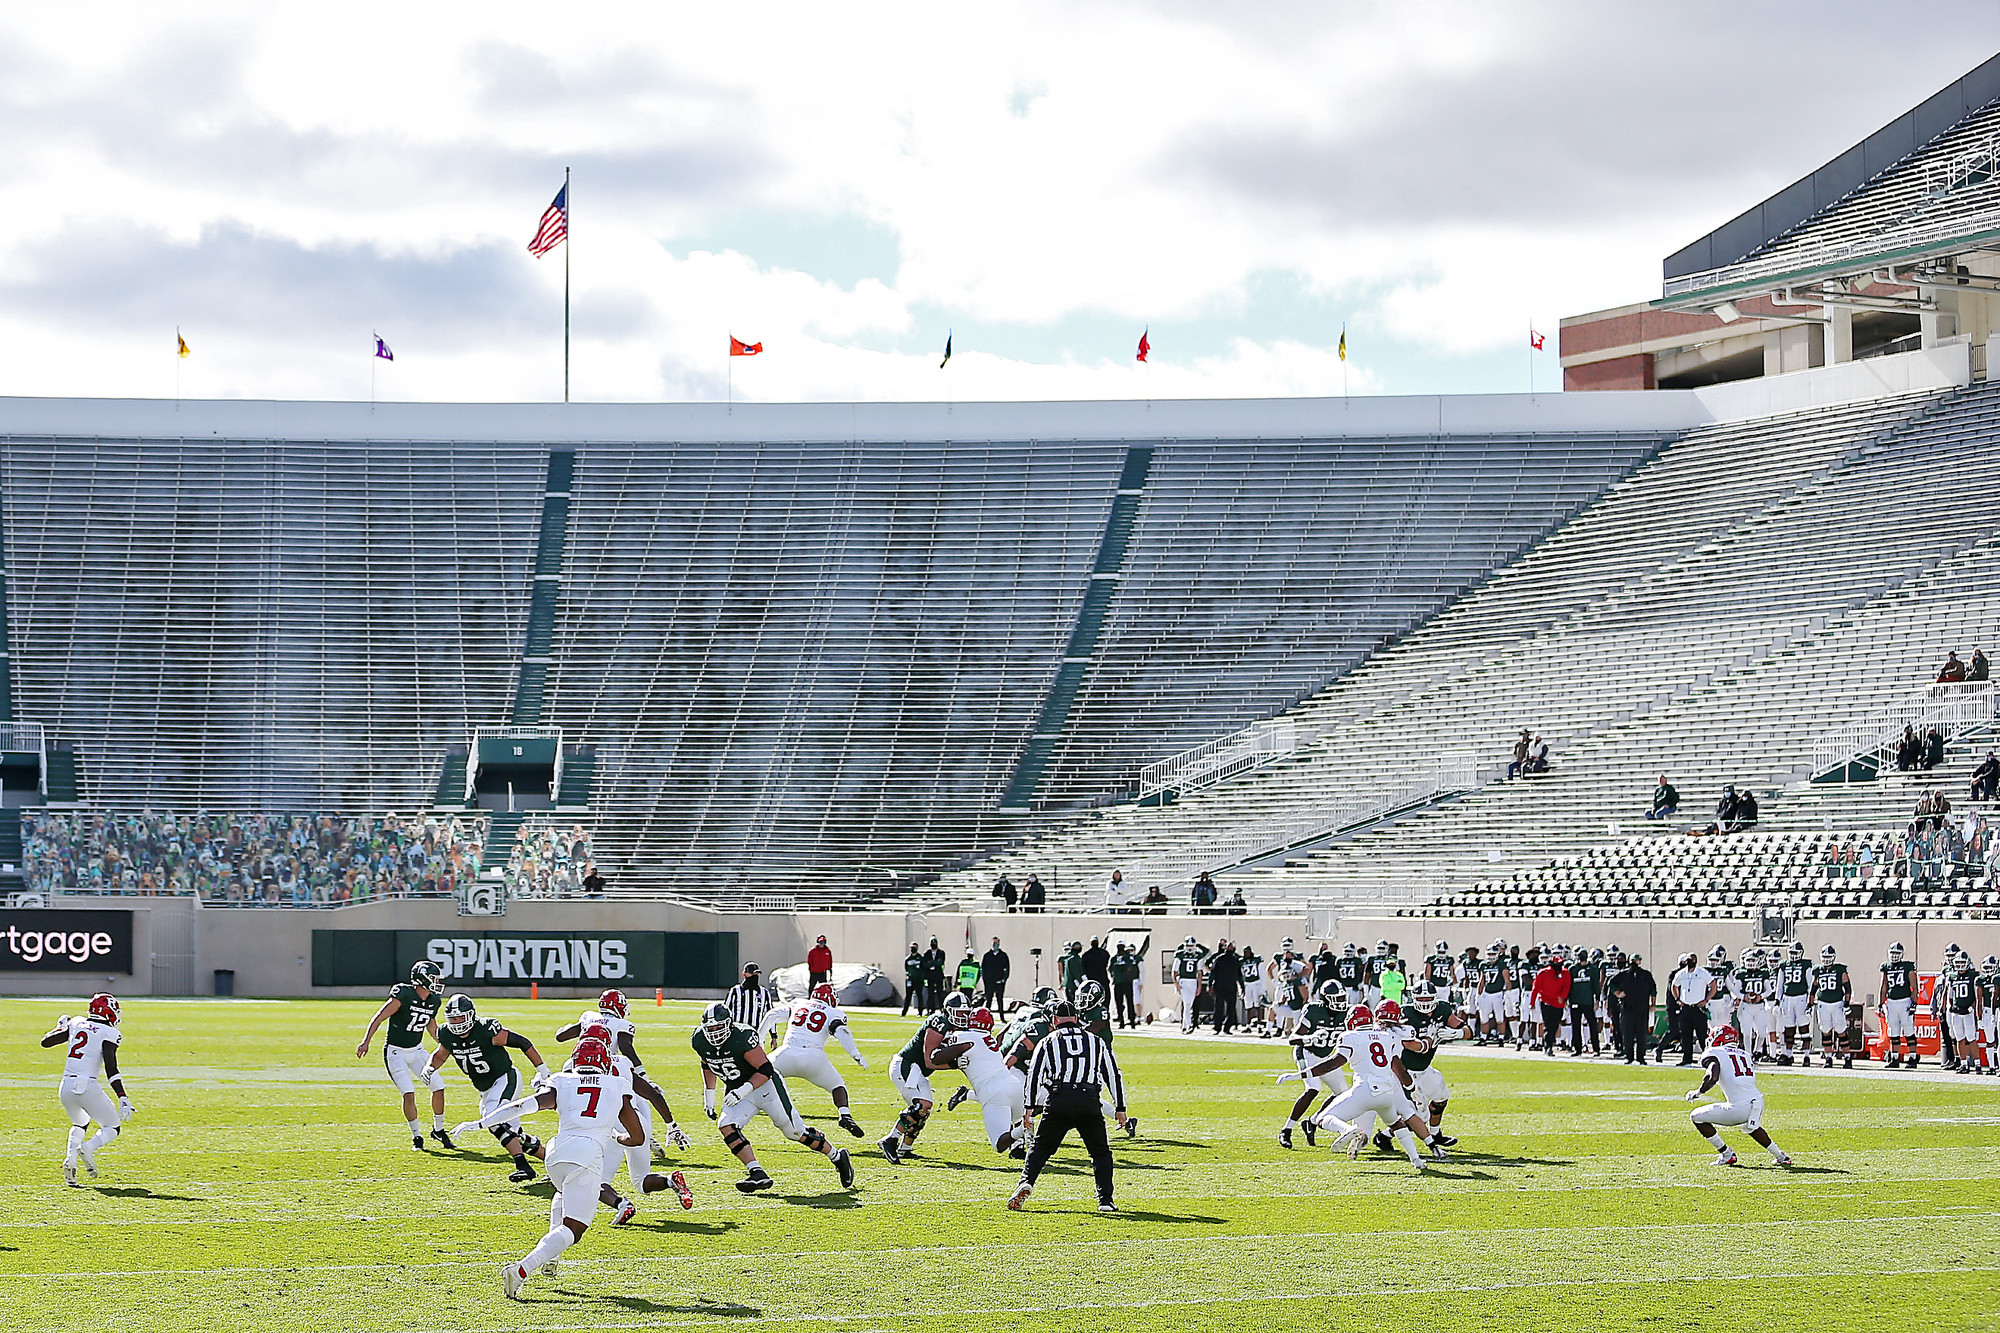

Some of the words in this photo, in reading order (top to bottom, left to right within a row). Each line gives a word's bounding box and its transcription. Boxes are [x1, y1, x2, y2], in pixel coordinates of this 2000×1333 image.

[512, 746, 523, 756] 18
[426, 938, 628, 979] SPARTANS
[1186, 961, 1194, 972] 6
[1243, 966, 1258, 977] 24
[1433, 967, 1449, 978] 45
[1784, 969, 1802, 984] 58
[1745, 981, 1763, 994] 40
[1819, 977, 1837, 991] 66
[1887, 974, 1905, 988] 54
[405, 1012, 431, 1032] 12
[1101, 1010, 1108, 1020] 5
[488, 1019, 503, 1035] 75
[931, 1016, 946, 1032] 64
[68, 1030, 89, 1060] 2
[1062, 1035, 1083, 1056] U
[453, 1052, 491, 1074] 75
[1369, 1042, 1389, 1068] 8
[707, 1062, 741, 1081] 56
[1729, 1054, 1754, 1077] 11
[576, 1086, 603, 1119] 7
